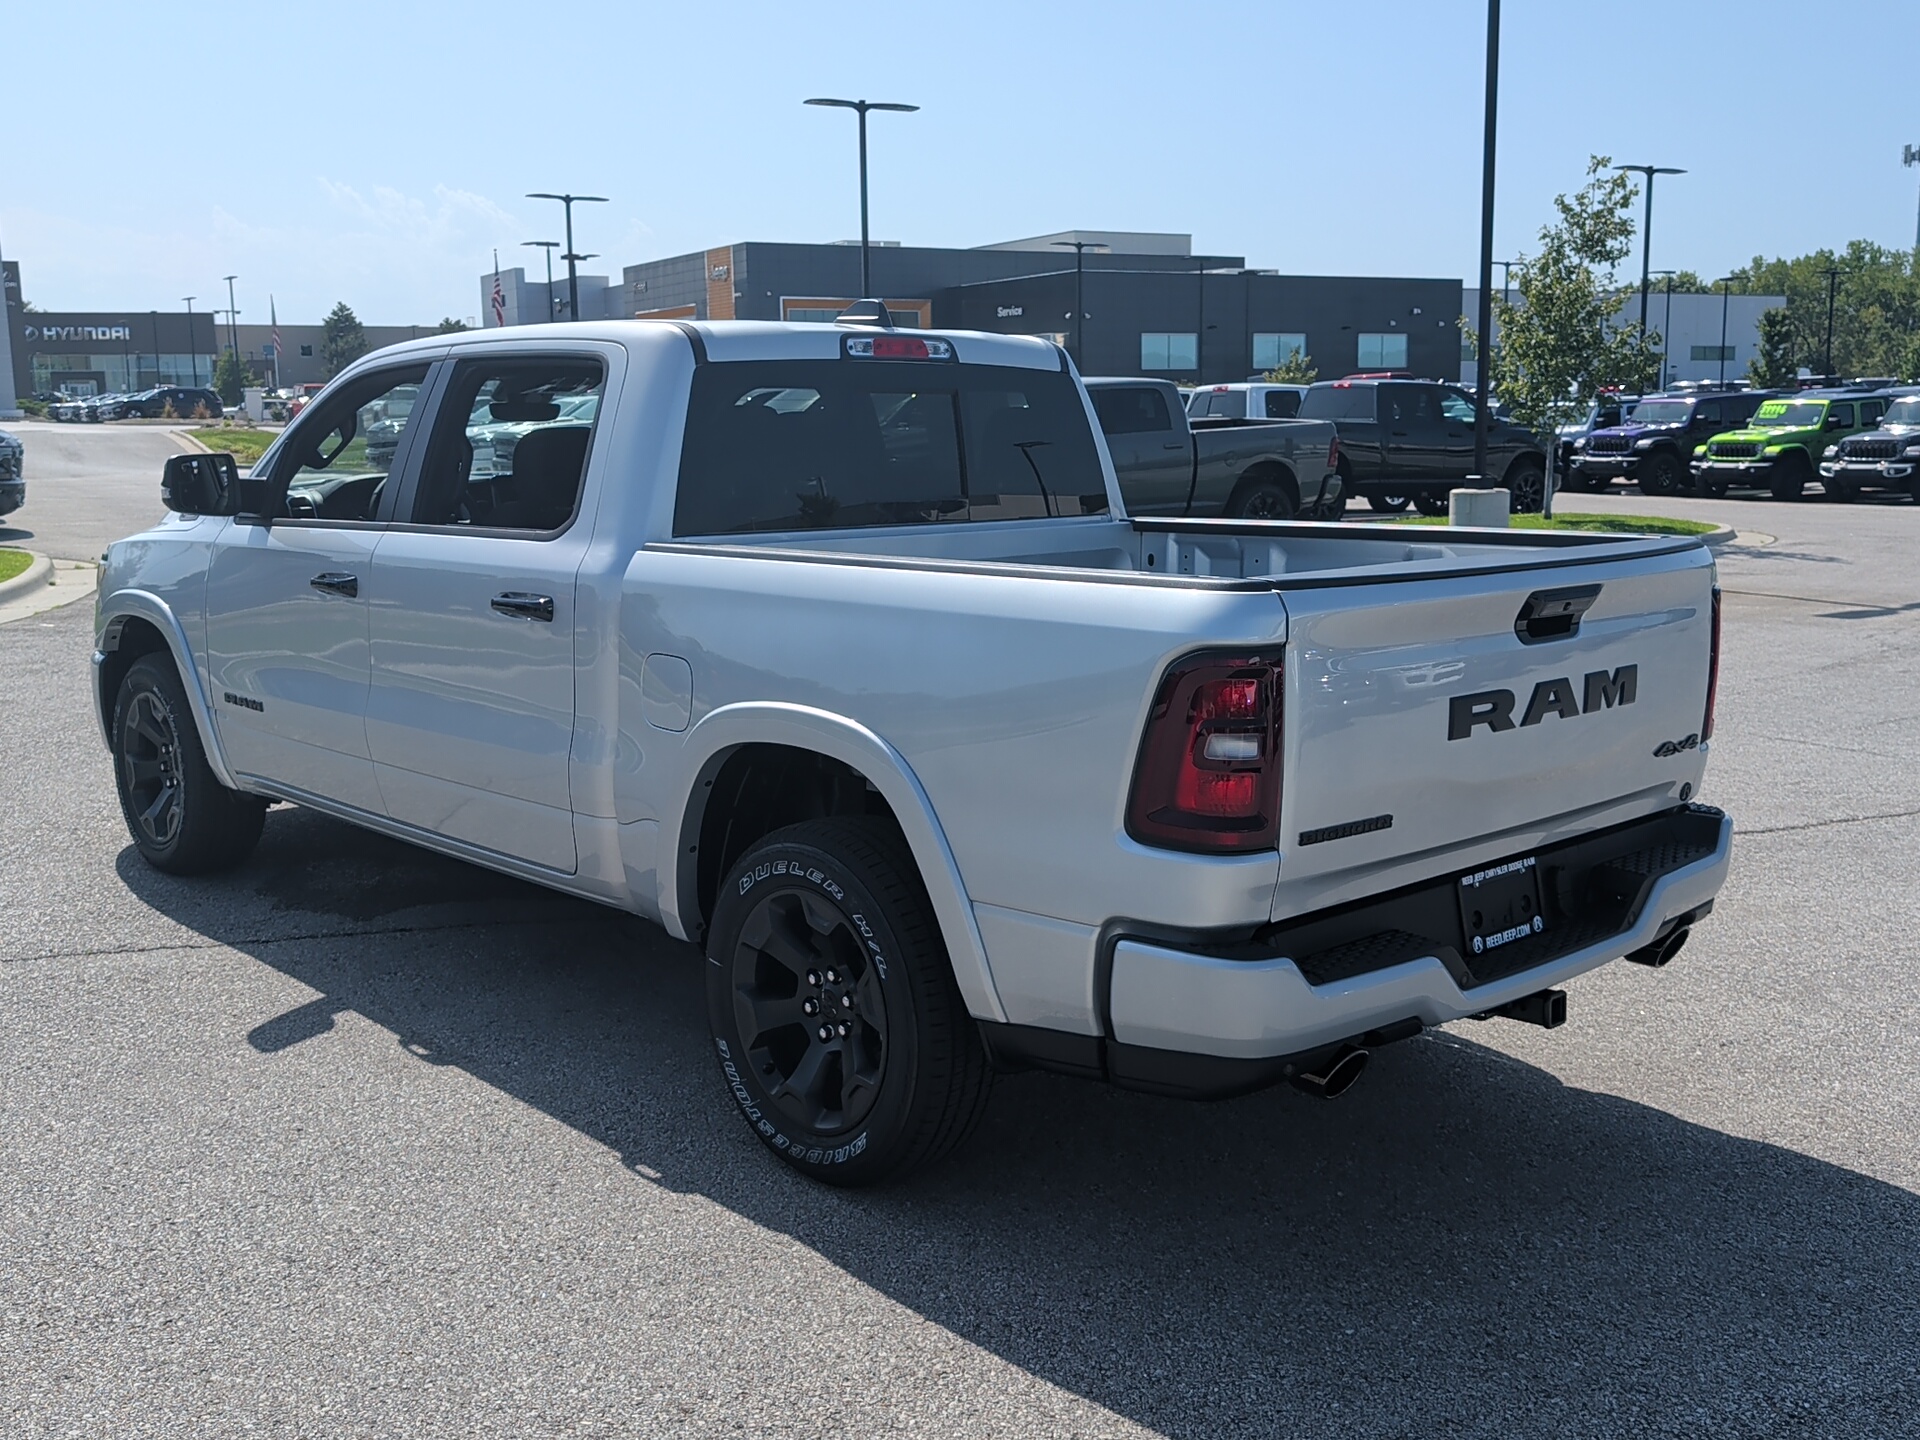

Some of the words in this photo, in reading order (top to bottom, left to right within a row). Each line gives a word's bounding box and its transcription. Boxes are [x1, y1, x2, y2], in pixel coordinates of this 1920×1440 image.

[997, 305, 1023, 317] Service
[43, 327, 130, 340] HYUNDAI
[1448, 664, 1637, 741] RAM
[739, 861, 843, 900] DUELER
[1474, 871, 1484, 882] JEEP
[1485, 865, 1508, 879] CHRYSLER
[1508, 860, 1523, 872] DODGE
[1523, 856, 1535, 867] RAM
[1485, 923, 1531, 948] REEDJEEP.COM
[716, 1038, 867, 1164] BRIDGESTONE
